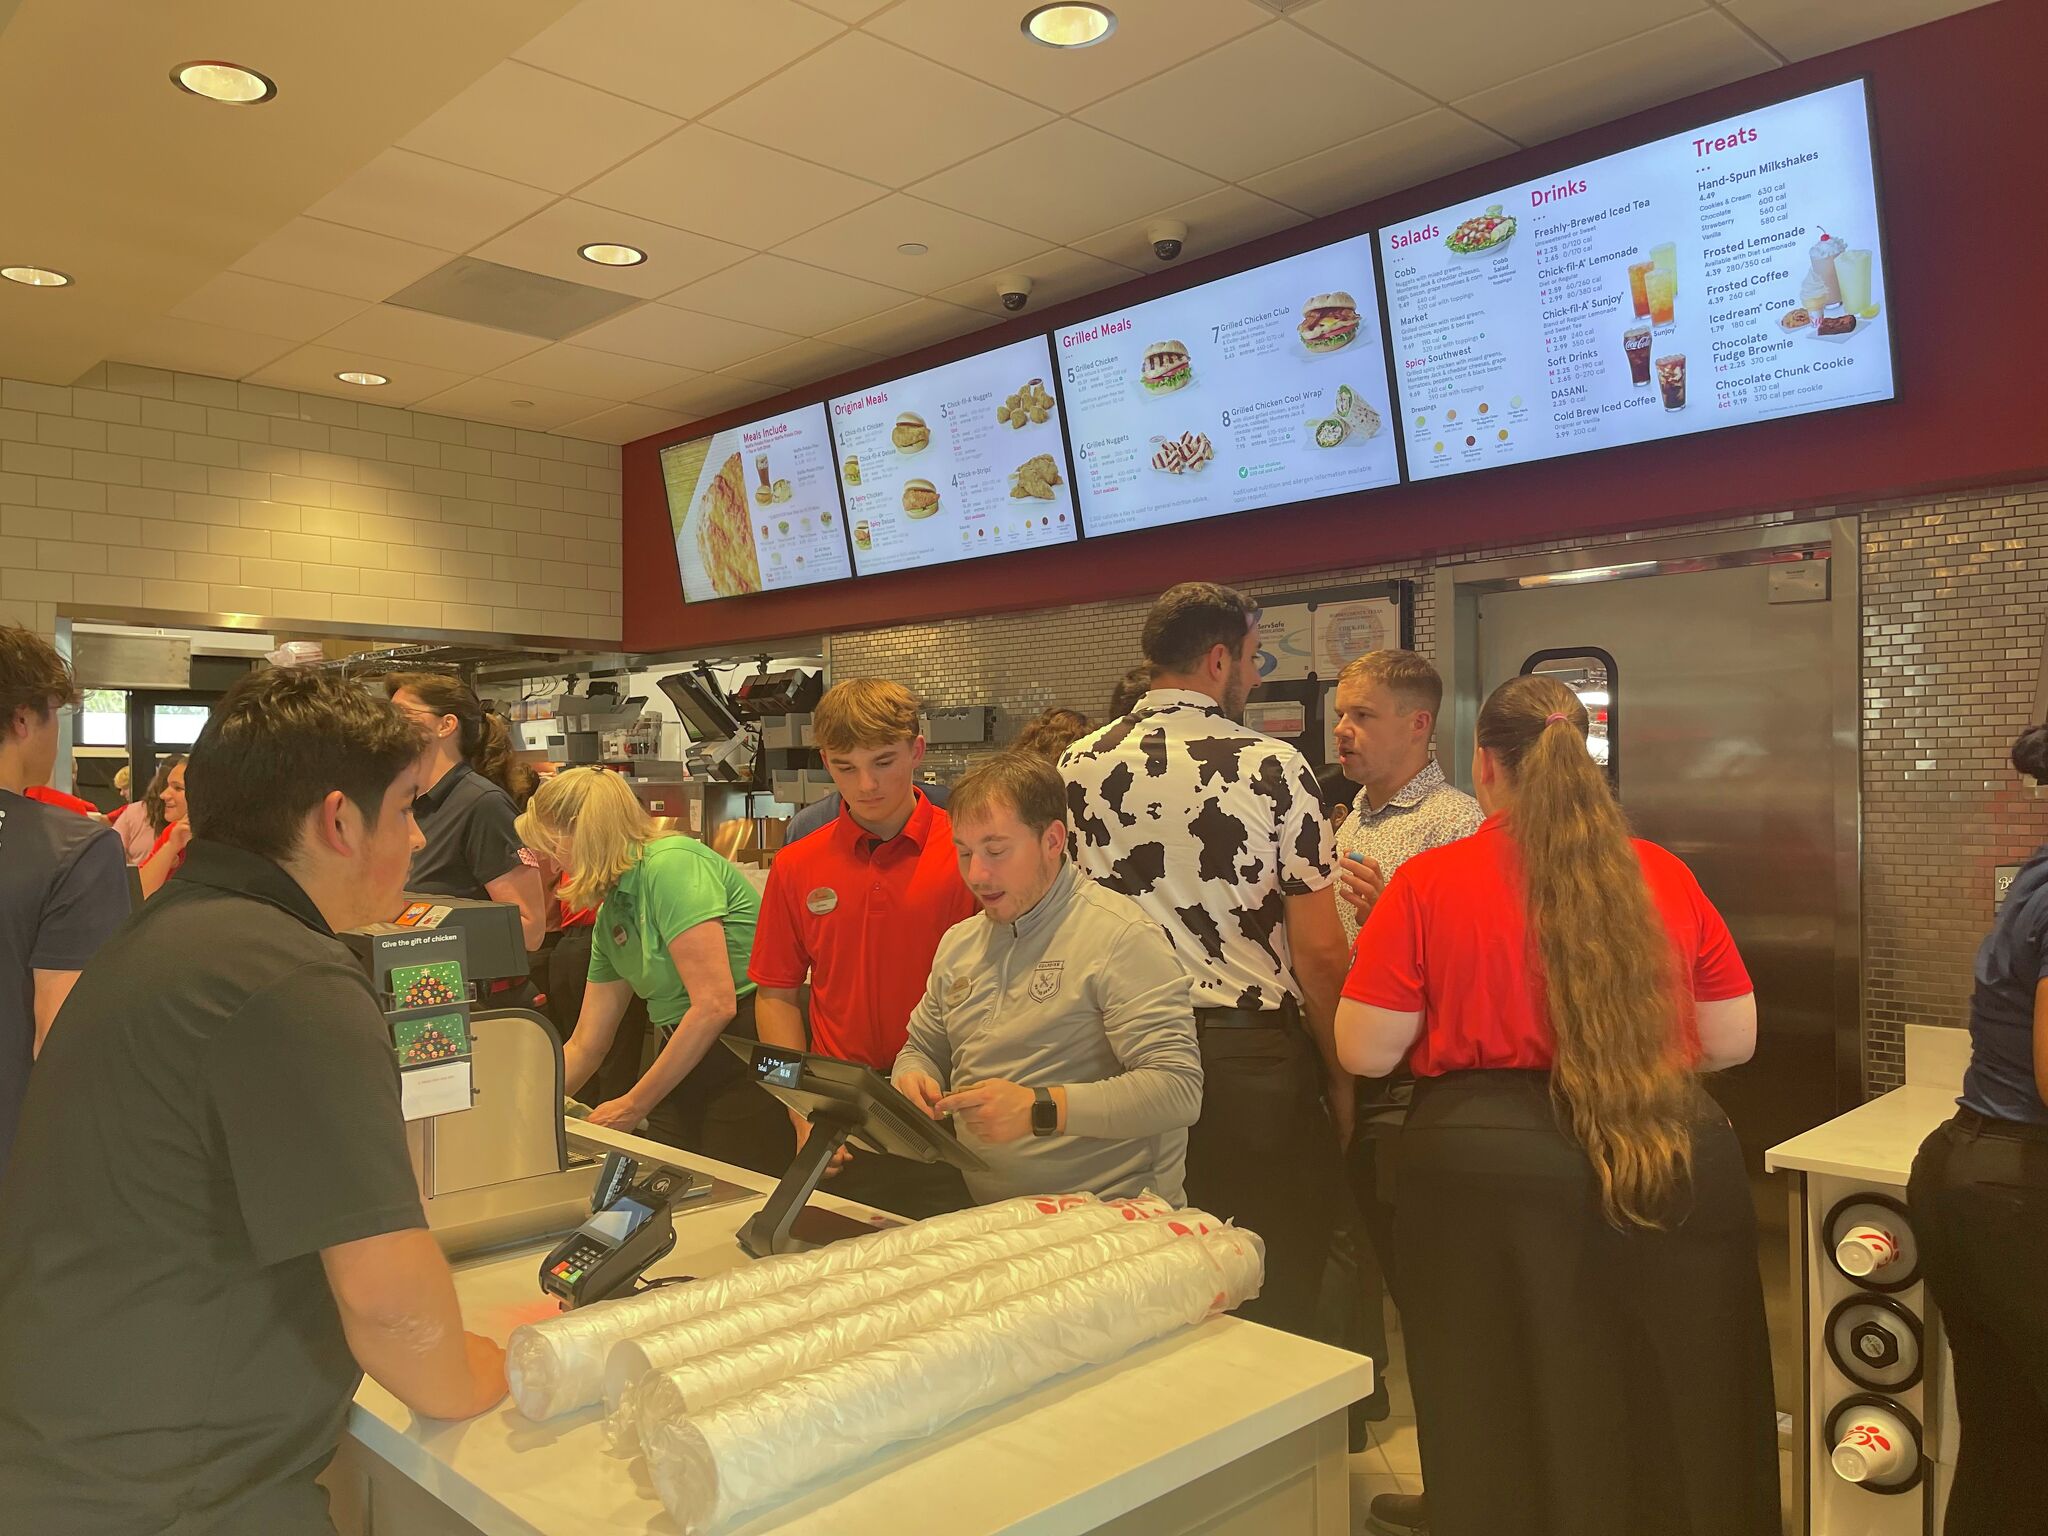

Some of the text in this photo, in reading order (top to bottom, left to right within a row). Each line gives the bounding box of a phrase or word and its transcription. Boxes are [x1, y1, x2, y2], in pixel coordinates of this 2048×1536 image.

[1692, 128, 1757, 157] Treats
[1698, 152, 1819, 192] Hand-Spun Milkshakes
[1531, 180, 1587, 207] Drinks
[1699, 191, 1715, 201] 4.49
[1699, 201, 1724, 212] Cookies
[1731, 193, 1752, 203] Cream
[1758, 186, 1772, 196] 630
[1774, 182, 1786, 192] cal
[1700, 192, 1787, 222] Chocolate 600 cal
[1534, 200, 1650, 239] Freshly-Brewed Iced Tea
[1701, 203, 1787, 231] Strawberry 560 cal
[1702, 212, 1788, 241] Vanilla 580 cal
[1391, 224, 1439, 249] Salads
[1583, 236, 1593, 244] cal
[1703, 227, 1805, 259] Frosted Lemonade
[1492, 257, 1509, 266] Cobb
[1589, 246, 1638, 266] Lemonade
[1705, 241, 1796, 268] Available with Diet Lemonade
[1394, 266, 1416, 279] Cobb
[1493, 264, 1509, 273] Salad
[1705, 255, 1772, 277] 4.39 280/350 cal
[1548, 286, 1562, 295] 2.59
[1566, 279, 1591, 290] 60/260
[1592, 276, 1602, 284] cal
[1707, 270, 1789, 296] Frosted Coffee
[1549, 294, 1563, 304] 2.99
[1593, 284, 1603, 292] cal
[1708, 289, 1756, 305] 4.39 260 cal
[1765, 299, 1795, 311] Cone
[1220, 306, 1290, 332] Grilled Chicken Club
[1400, 312, 1428, 326] Market
[1567, 314, 1587, 323] Regular
[1588, 306, 1617, 318] Lemonade
[1063, 318, 1132, 348] Grilled Meals
[1555, 325, 1572, 333] Sweet
[1584, 328, 1594, 336] cal
[1710, 317, 1757, 333] 1.79 180 cal
[1211, 326, 1220, 344] 7
[1712, 333, 1768, 351] Chocolate
[1554, 343, 1568, 352] 2.99
[1585, 336, 1596, 345] cal
[1713, 339, 1793, 363] Fudge Brownie
[1075, 356, 1118, 373] Grilled Chicken
[1406, 346, 1472, 369] Spicy Southwest
[1548, 350, 1598, 367] Soft Drinks
[1729, 360, 1746, 370] 2.25
[1751, 356, 1764, 365] 370
[1766, 354, 1777, 362] cal
[1067, 367, 1075, 383] 5
[1716, 356, 1854, 390] Chocolate Chunk Cookie
[973, 392, 993, 402] Nuggets
[1732, 388, 1747, 397] 1.65
[1754, 385, 1767, 393] 370
[1769, 382, 1780, 390] cal
[1733, 397, 1747, 406] 9.19
[1754, 393, 1768, 402] 370
[1770, 391, 1781, 399] cal
[1782, 389, 1795, 399] per
[1797, 384, 1823, 394] cookie
[835, 392, 888, 416] Original Meals
[1231, 405, 1254, 416] Grilled
[1255, 399, 1283, 410] Chicken
[1284, 393, 1302, 404] Cool
[1411, 404, 1437, 414] Dressings
[1553, 399, 1567, 408] 2.25
[1576, 395, 1586, 403] cal
[1554, 396, 1656, 422] Cold Brew Iced Coffee
[940, 404, 948, 419] 3
[1222, 410, 1231, 427] 8
[762, 423, 787, 437] Include
[1556, 431, 1569, 439] 3.99
[1574, 427, 1586, 436] 200
[839, 433, 846, 446] 1
[1079, 444, 1087, 460] 6
[952, 474, 958, 488] 4
[850, 497, 856, 510] 2
[381, 934, 457, 949] Give the gift of chicken
